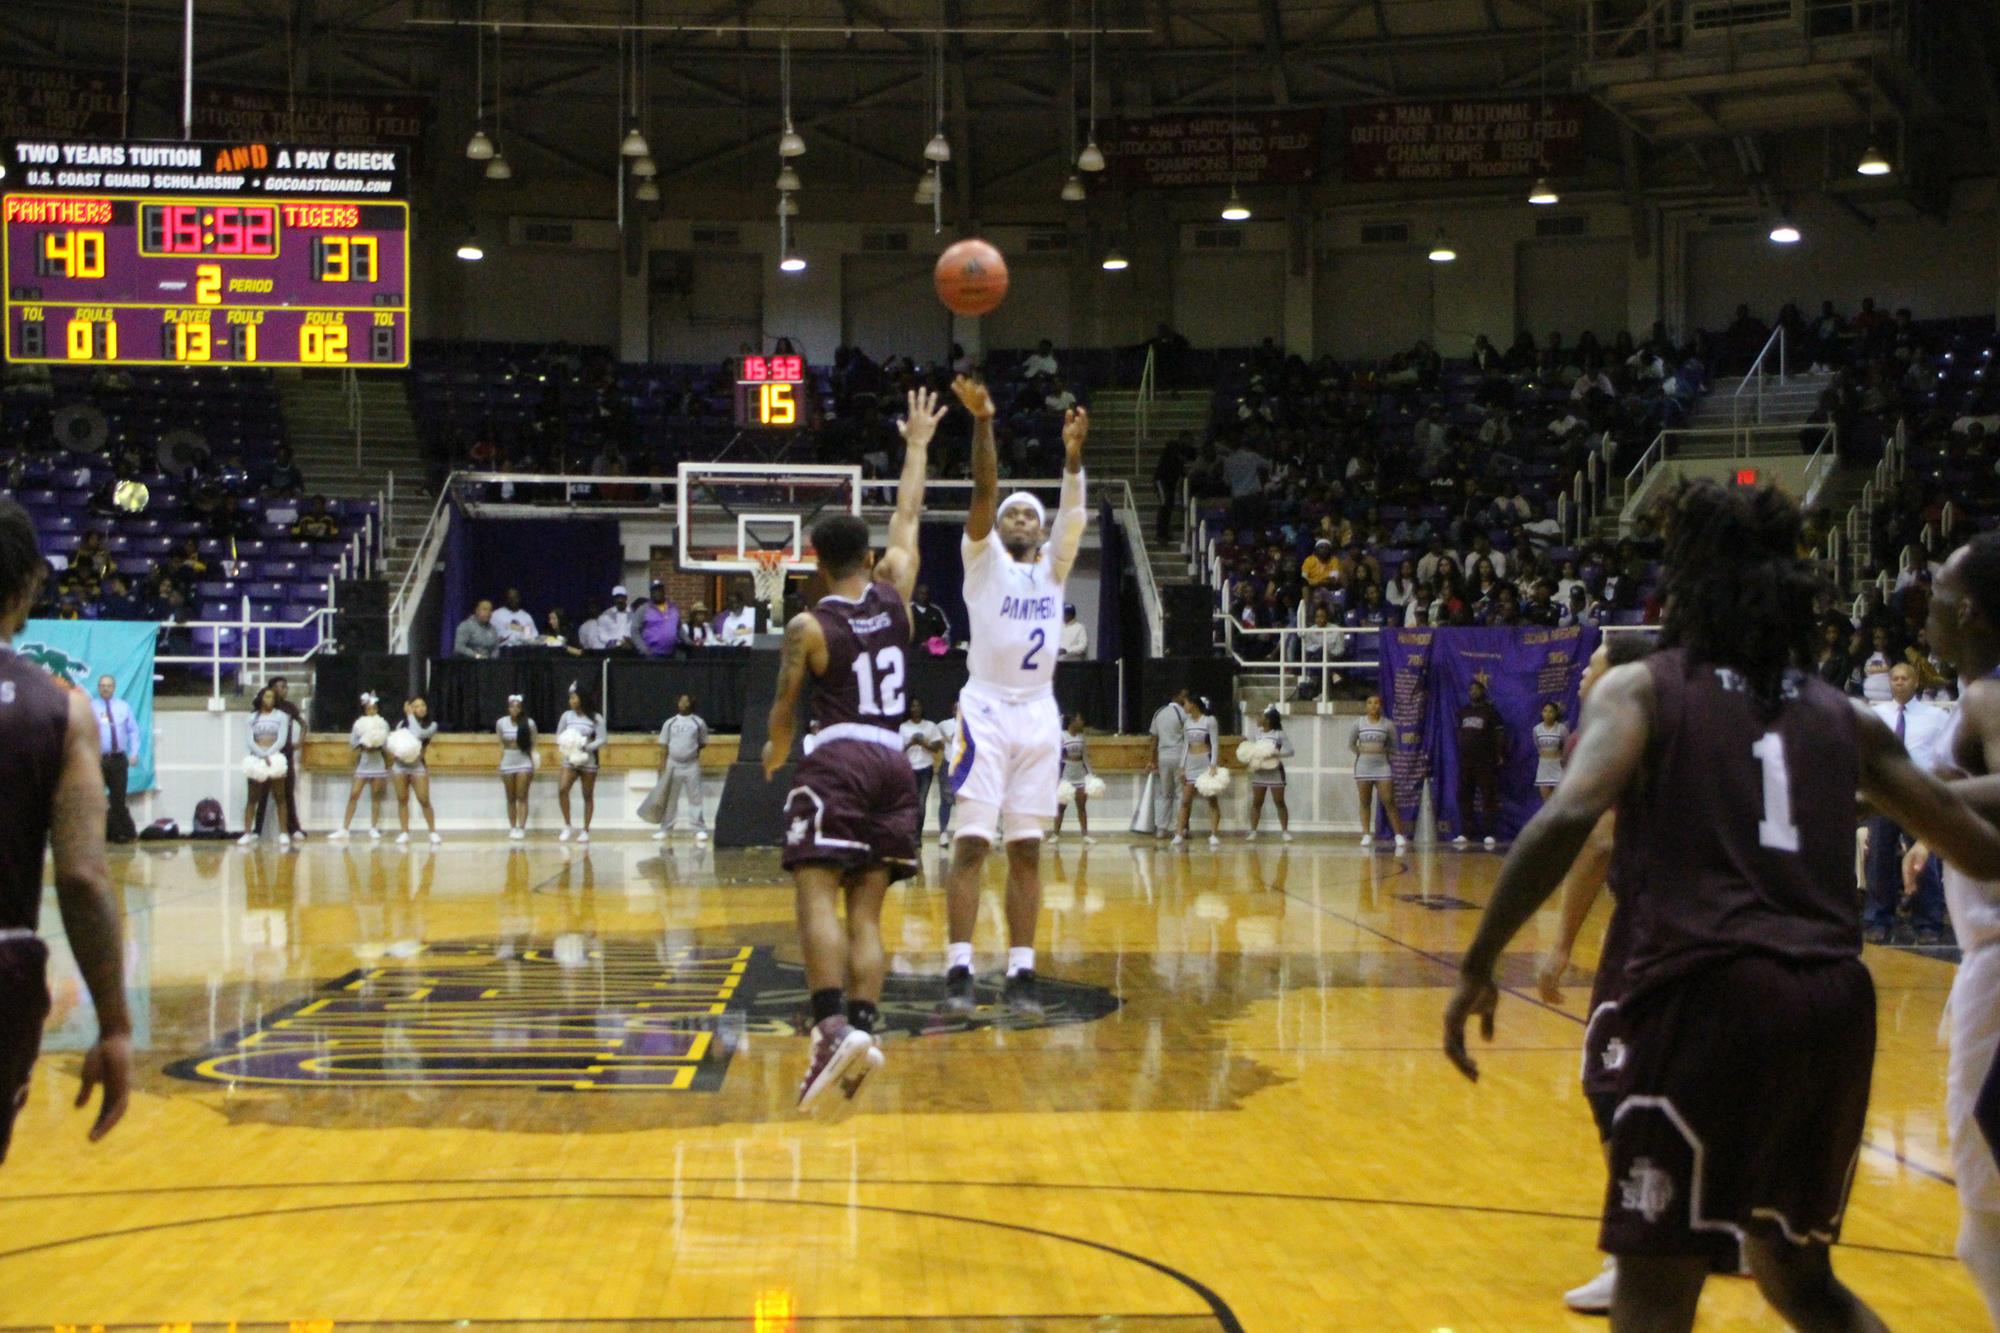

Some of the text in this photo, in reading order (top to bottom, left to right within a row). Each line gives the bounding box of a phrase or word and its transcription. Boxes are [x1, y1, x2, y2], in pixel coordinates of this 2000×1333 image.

[1451, 103, 1531, 122] NATIONAL
[1351, 125, 1427, 143] OUTDOOR
[1433, 123, 1488, 142] TRACK
[1493, 122, 1529, 141] AND
[16, 143, 396, 173] TWO YEARS TUITION AND A PAY CHECK
[1386, 143, 1484, 163] CHAMPIONS
[26, 170, 54, 186] U.S.
[57, 172, 102, 188] COAST
[104, 174, 151, 189] GUARD
[153, 174, 245, 191] SCHOLARSHIP
[6, 200, 113, 224] PANTHERS
[283, 205, 360, 229] TIGERS
[45, 230, 106, 279] 40
[321, 235, 379, 283] 37
[196, 264, 223, 305] 2
[228, 279, 274, 294] PERIOD
[22, 308, 46, 321] TOL
[75, 308, 114, 321] FOULS
[163, 309, 265, 324] PLAYER FOULS
[304, 311, 345, 325] FOULS
[372, 313, 396, 329] TOL
[67, 319, 118, 361] 01
[298, 323, 348, 363] 02
[744, 356, 802, 380] 15:52
[760, 383, 796, 425] 15
[1020, 627, 1046, 670] 2
[851, 645, 905, 716] 12
[1751, 732, 1799, 852] 1
